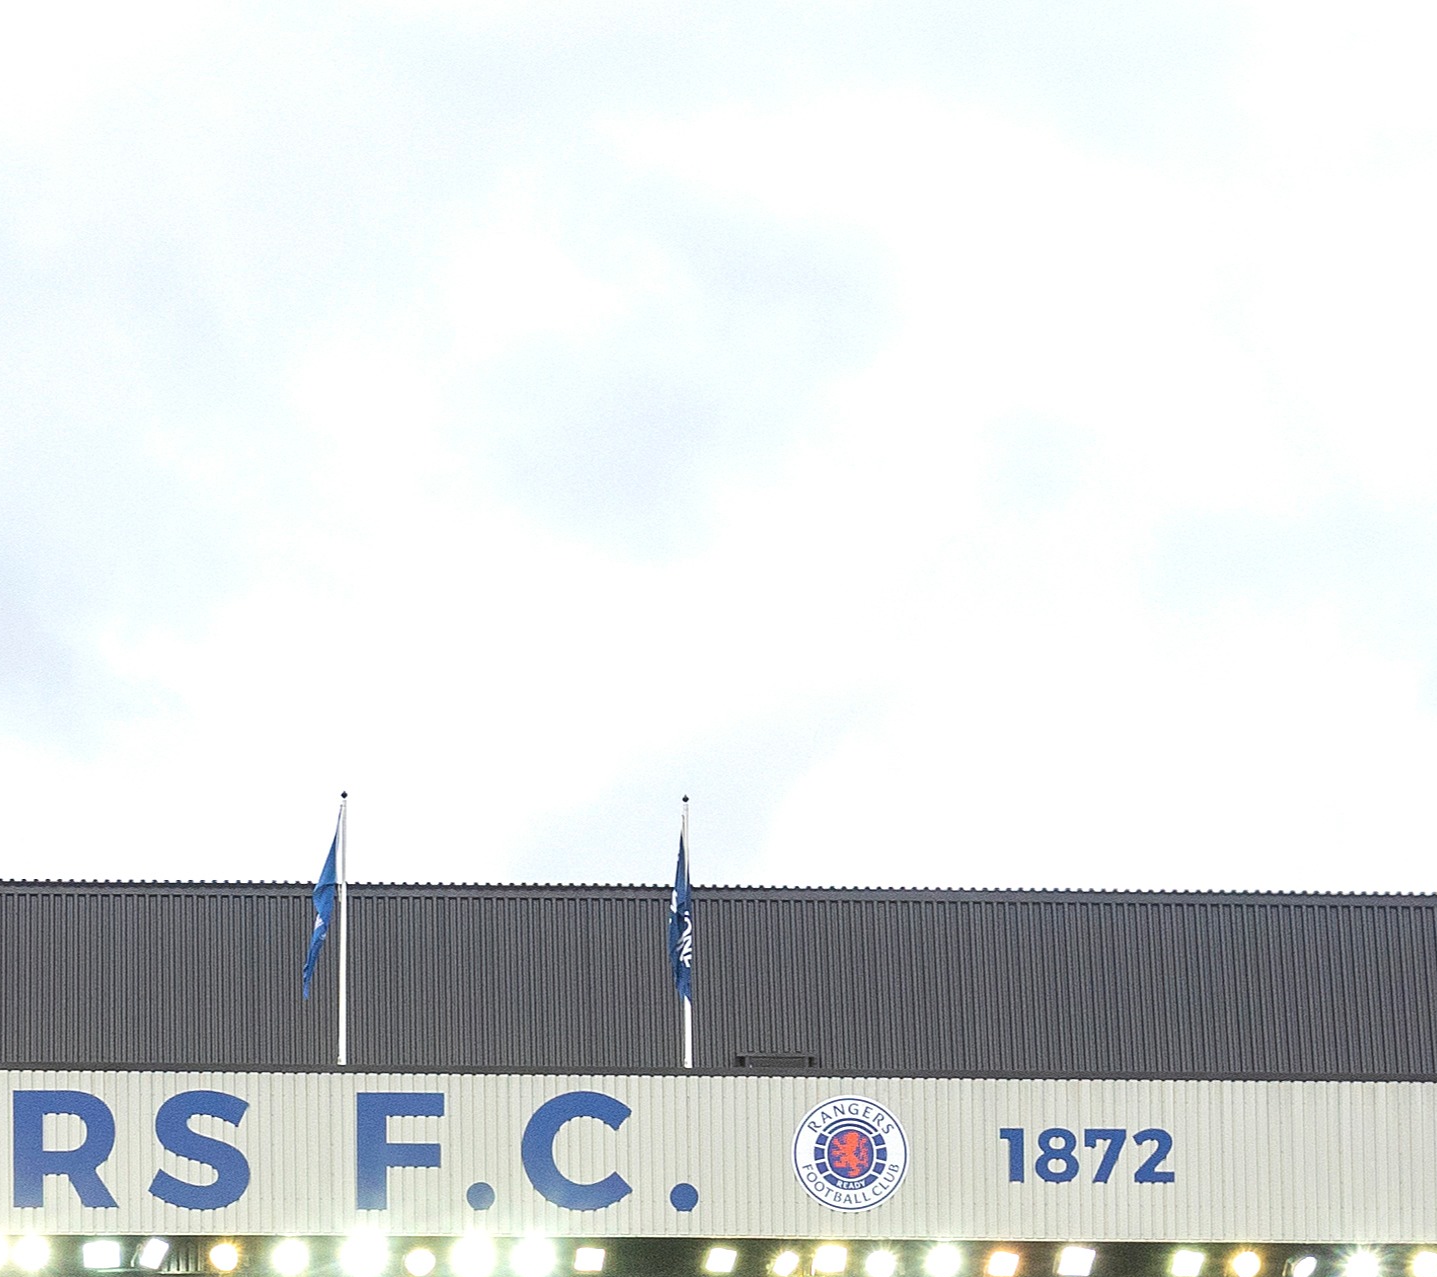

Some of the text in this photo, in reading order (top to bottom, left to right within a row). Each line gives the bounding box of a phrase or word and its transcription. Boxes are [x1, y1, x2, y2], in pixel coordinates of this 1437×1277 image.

[807, 1103, 895, 1135] RANGERS
[357, 1091, 700, 1213] F.C.
[1000, 1127, 1175, 1185] 1872
[802, 1163, 900, 1204] FOOTBALL CLUB
[836, 1180, 866, 1189] READY
